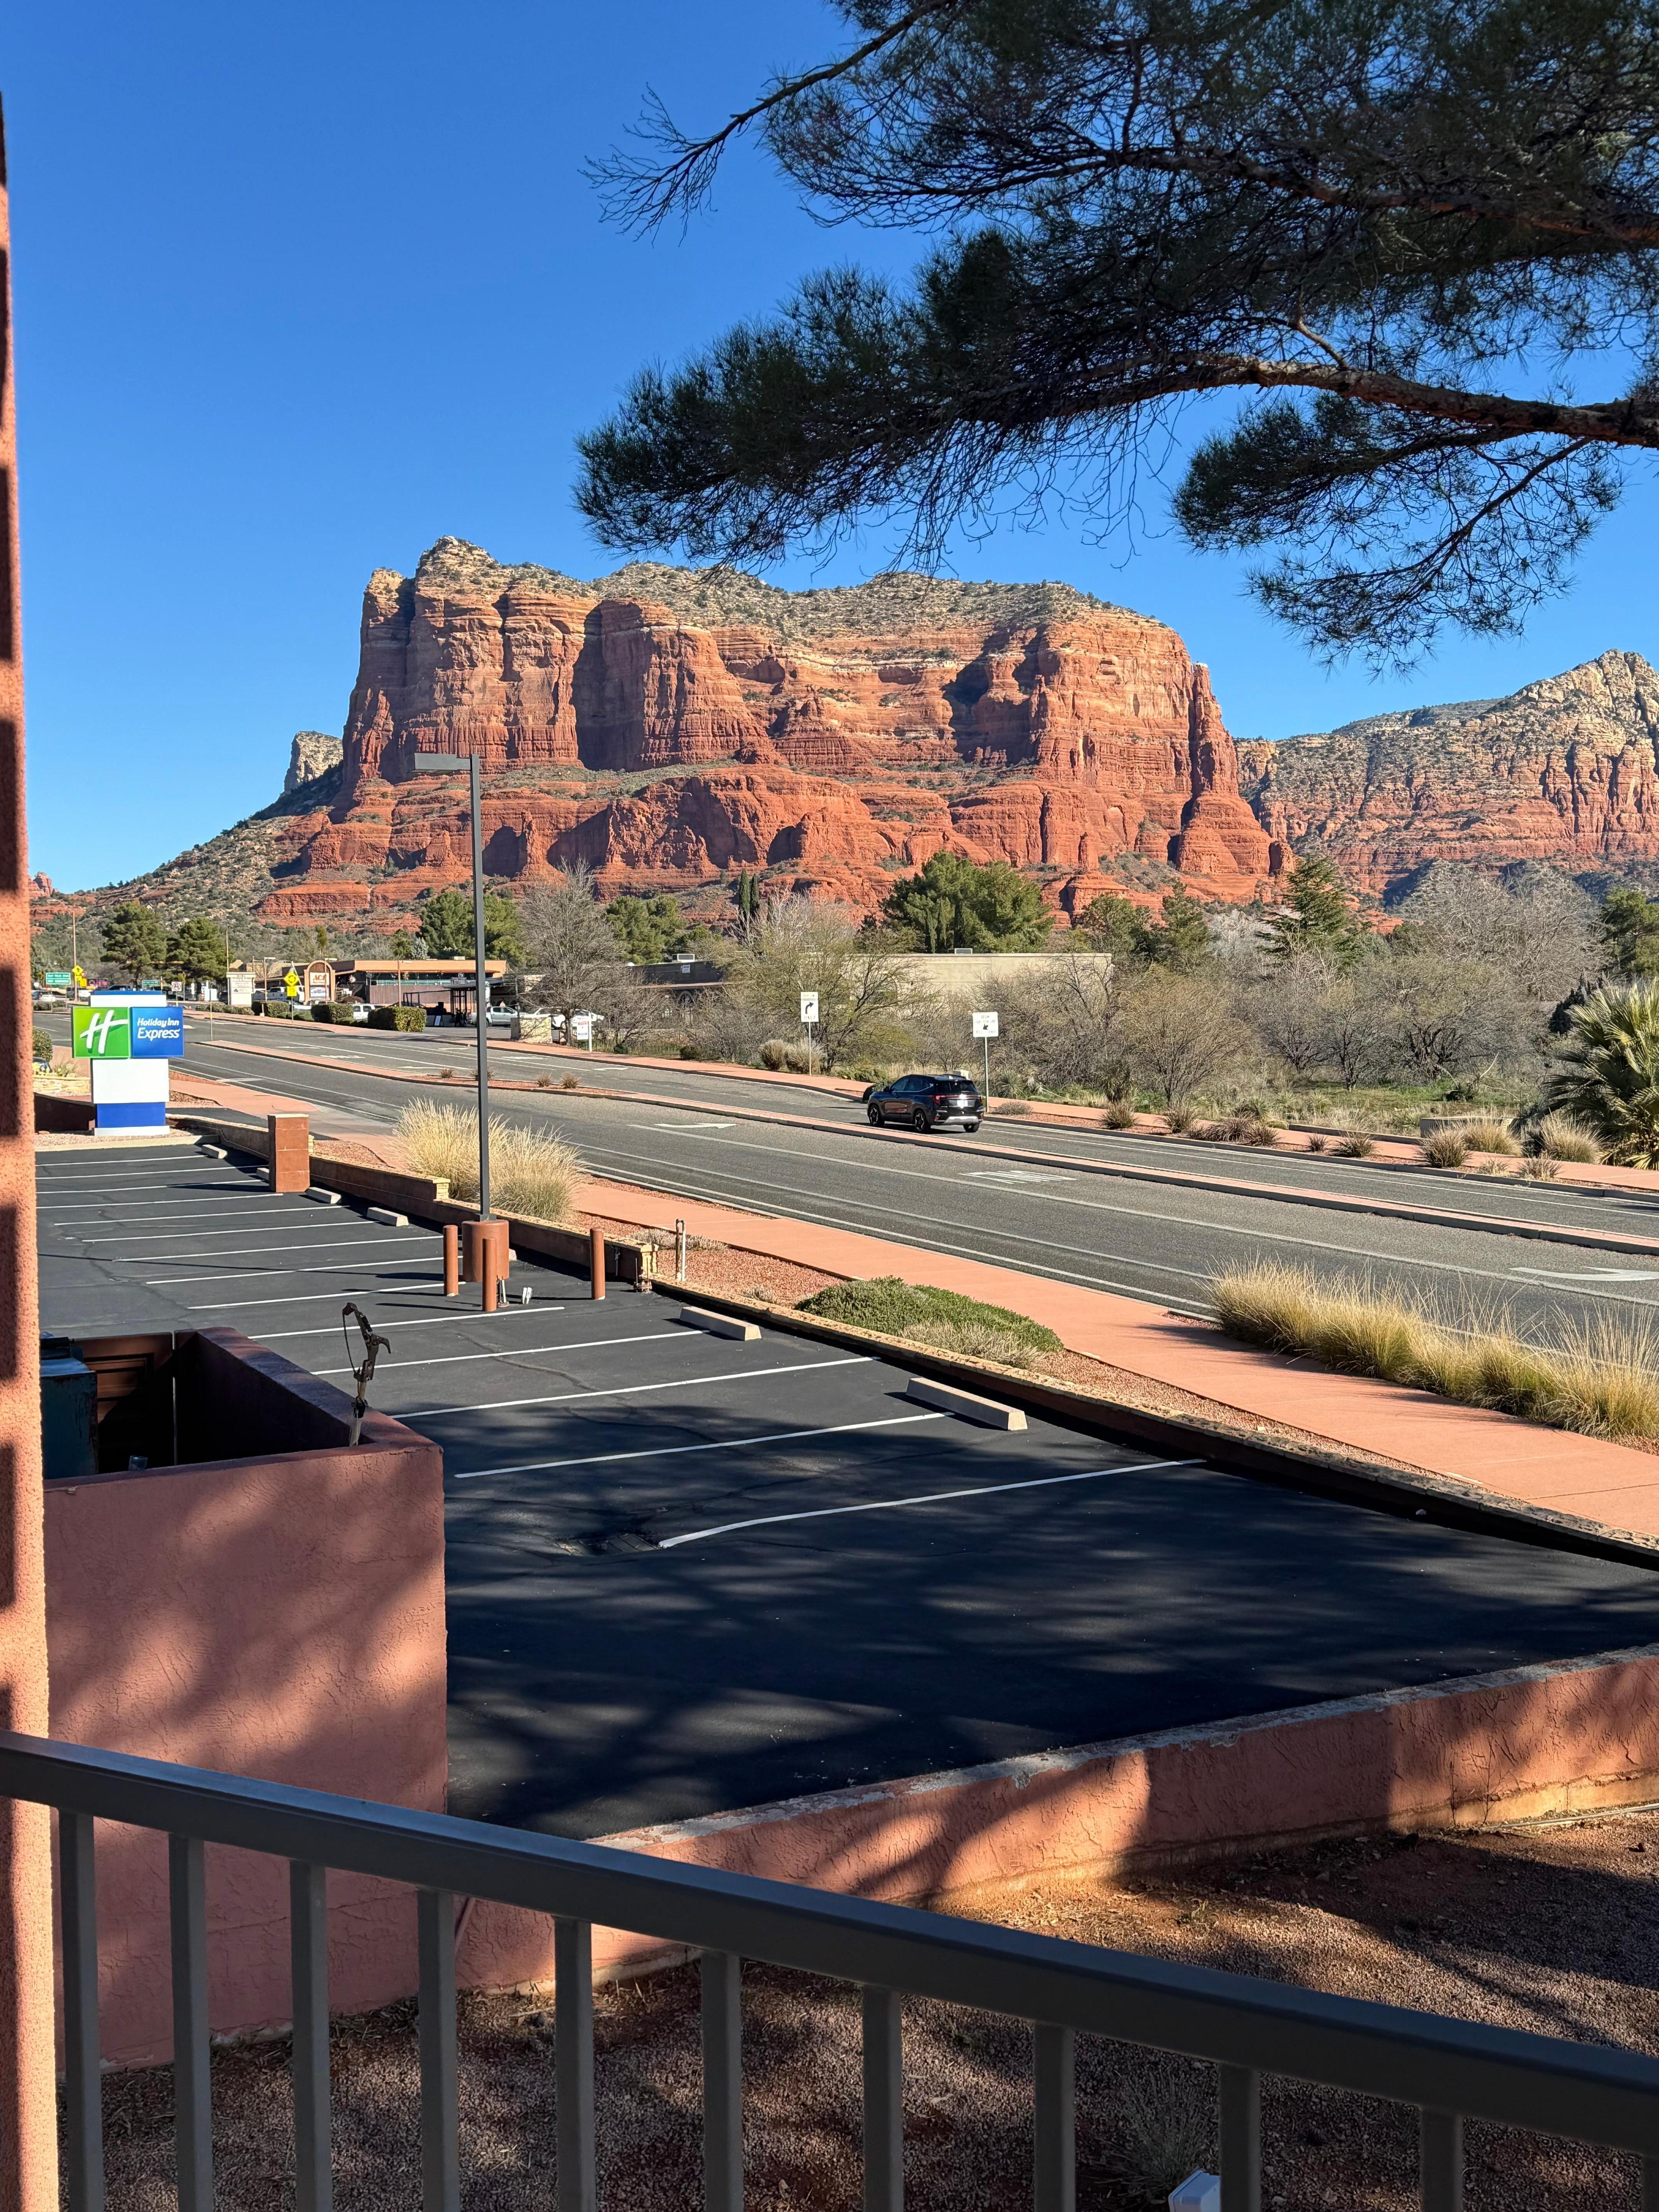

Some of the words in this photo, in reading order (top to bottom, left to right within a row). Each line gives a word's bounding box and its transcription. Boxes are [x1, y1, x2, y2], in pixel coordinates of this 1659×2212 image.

[137, 1018, 167, 1027] Holiday
[167, 1018, 179, 1026] Inn
[137, 1027, 180, 1041] Express
